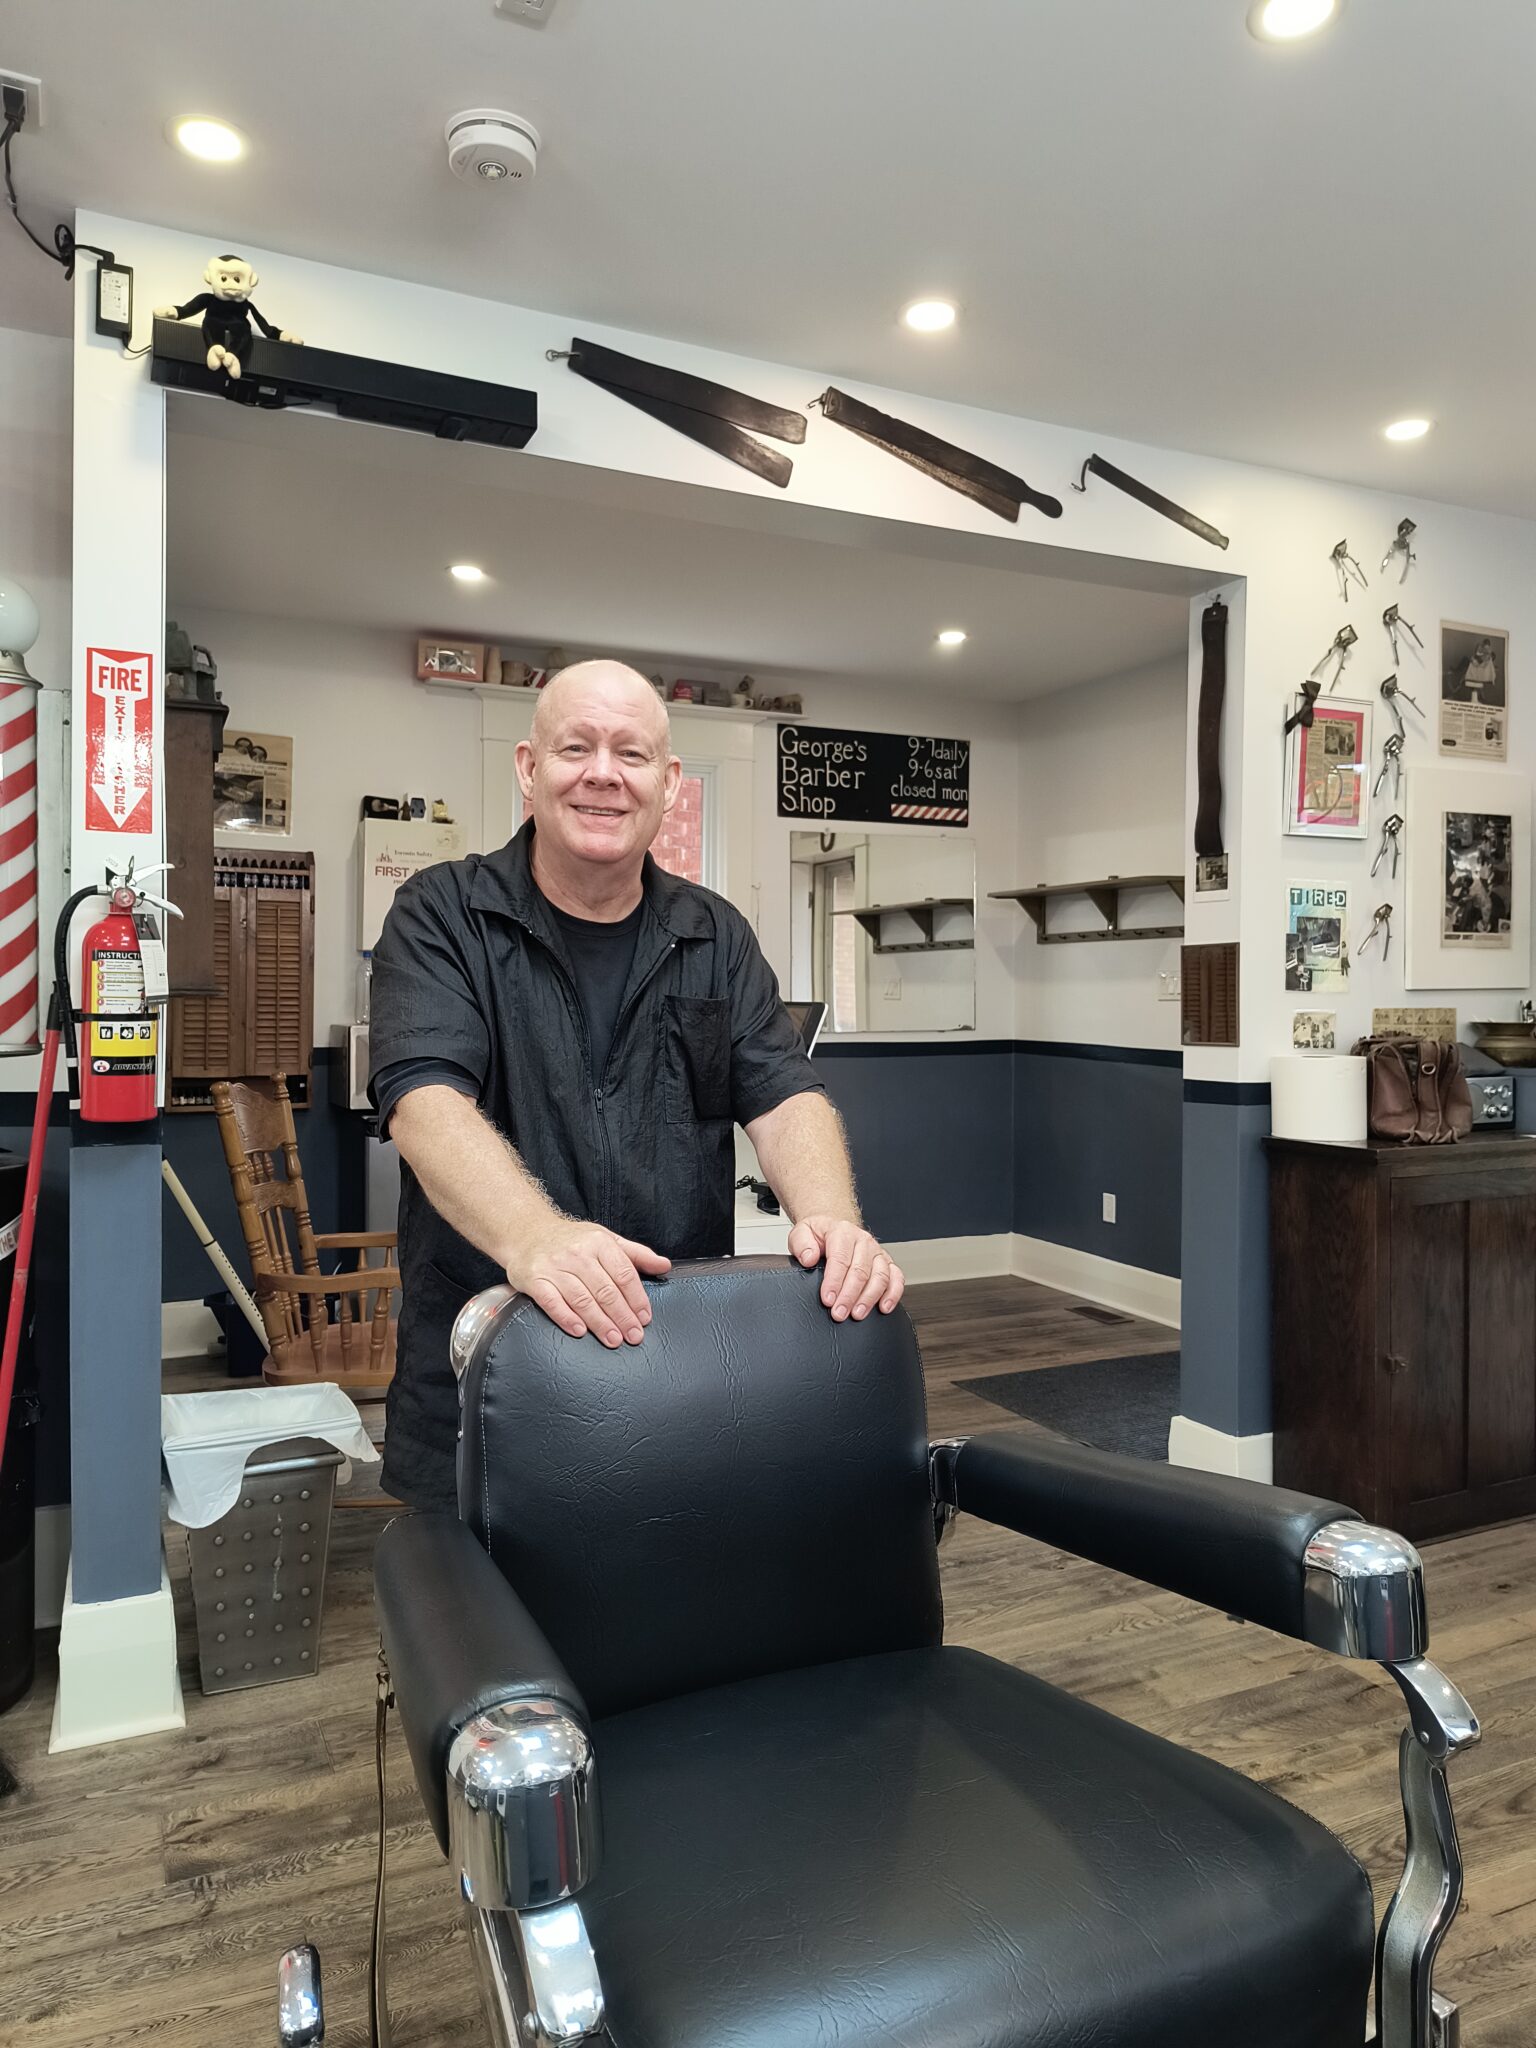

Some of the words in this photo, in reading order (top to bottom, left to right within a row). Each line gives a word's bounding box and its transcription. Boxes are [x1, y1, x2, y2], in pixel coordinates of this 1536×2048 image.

[98, 665, 142, 692] FIRE
[779, 727, 868, 764] George's
[934, 741, 968, 769] daily
[780, 756, 866, 790] Barber
[934, 763, 959, 780] sat
[890, 774, 936, 799] closed
[942, 786, 969, 801] mon
[781, 785, 837, 820] Shop
[375, 865, 410, 878] FIRST
[1289, 888, 1347, 908] TIRED
[98, 951, 141, 960] INSTRUCTI
